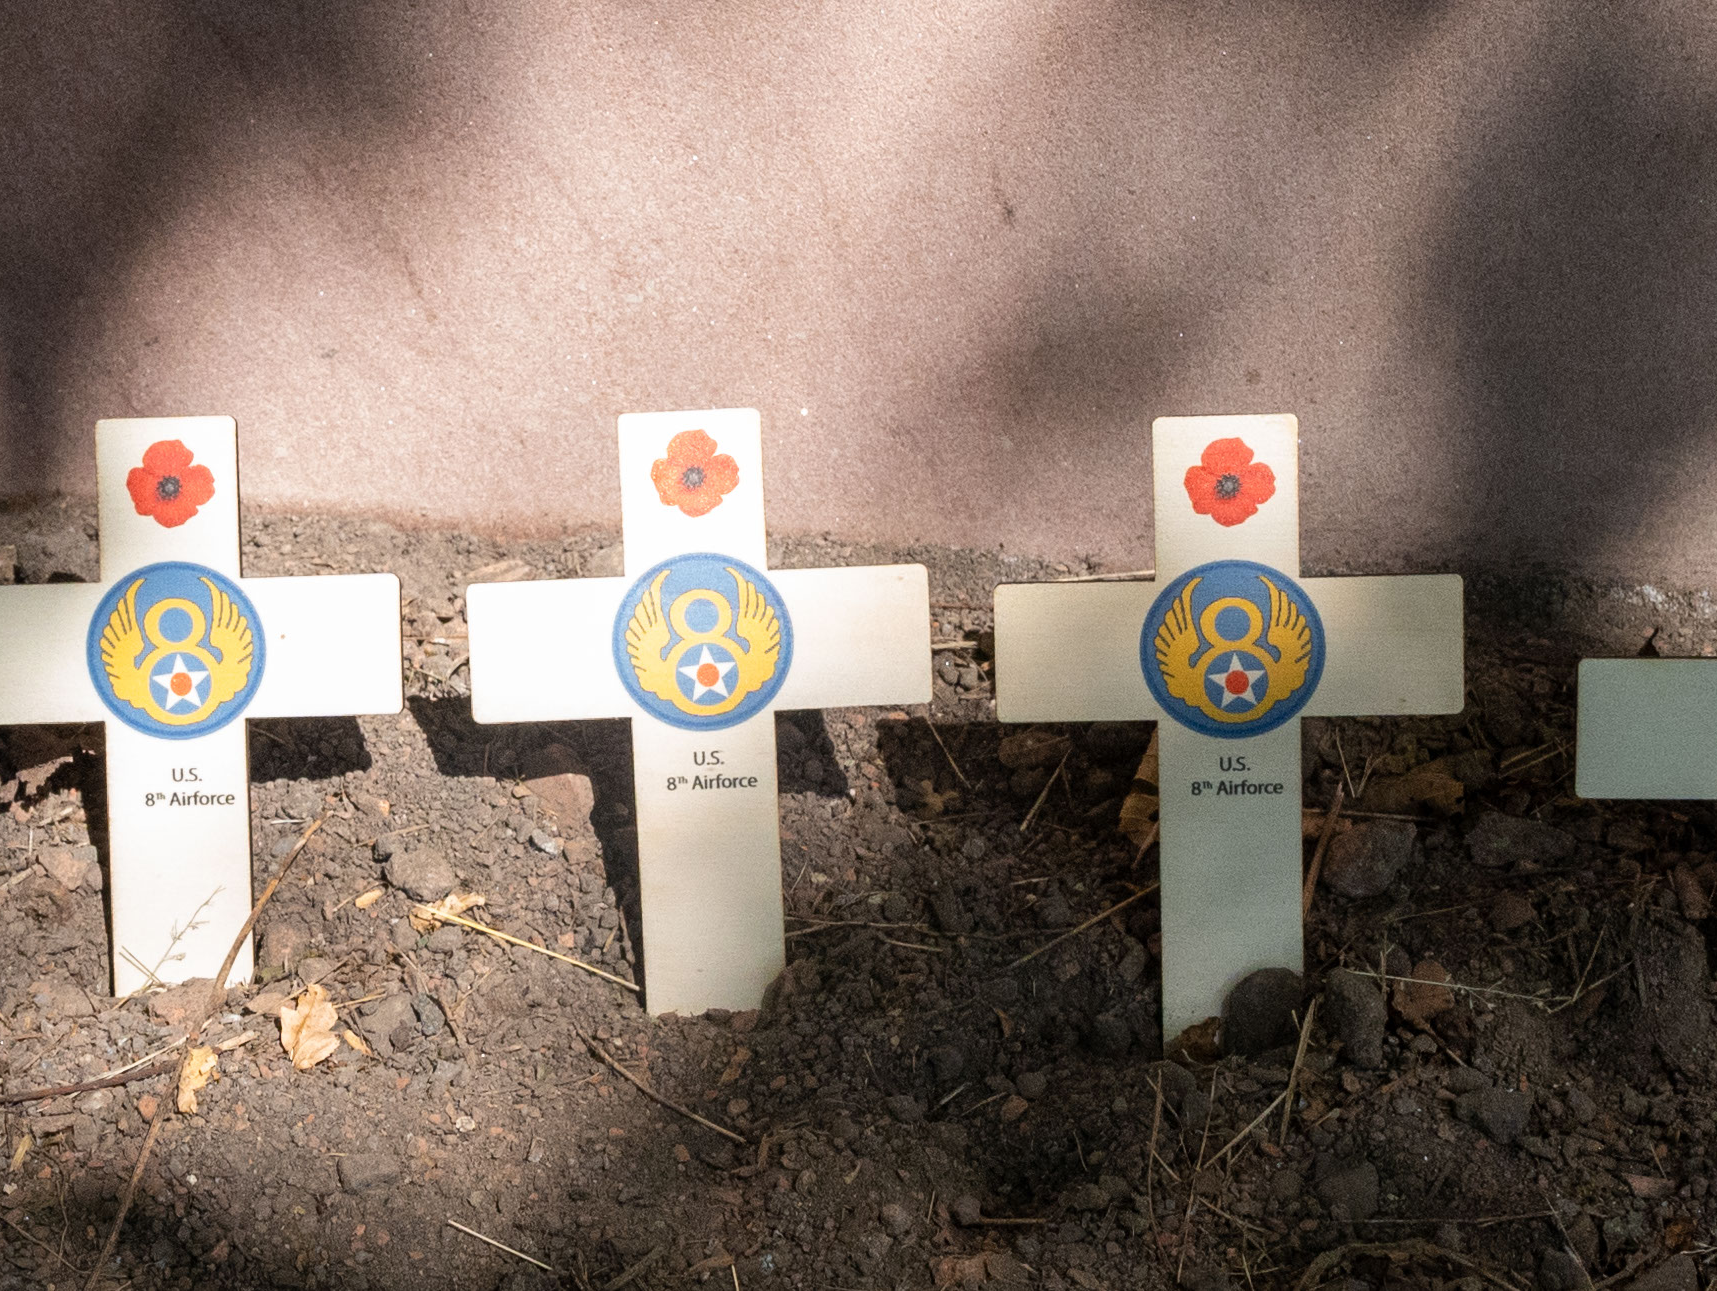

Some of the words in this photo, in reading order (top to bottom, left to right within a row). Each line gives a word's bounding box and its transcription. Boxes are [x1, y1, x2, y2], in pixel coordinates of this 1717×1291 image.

[694, 751, 724, 766] U.S.
[1220, 757, 1250, 771] U.S.
[172, 768, 202, 782] U.S.
[692, 774, 758, 789] Airforce
[1217, 780, 1283, 795] Airforce
[170, 791, 235, 805] Airforce
